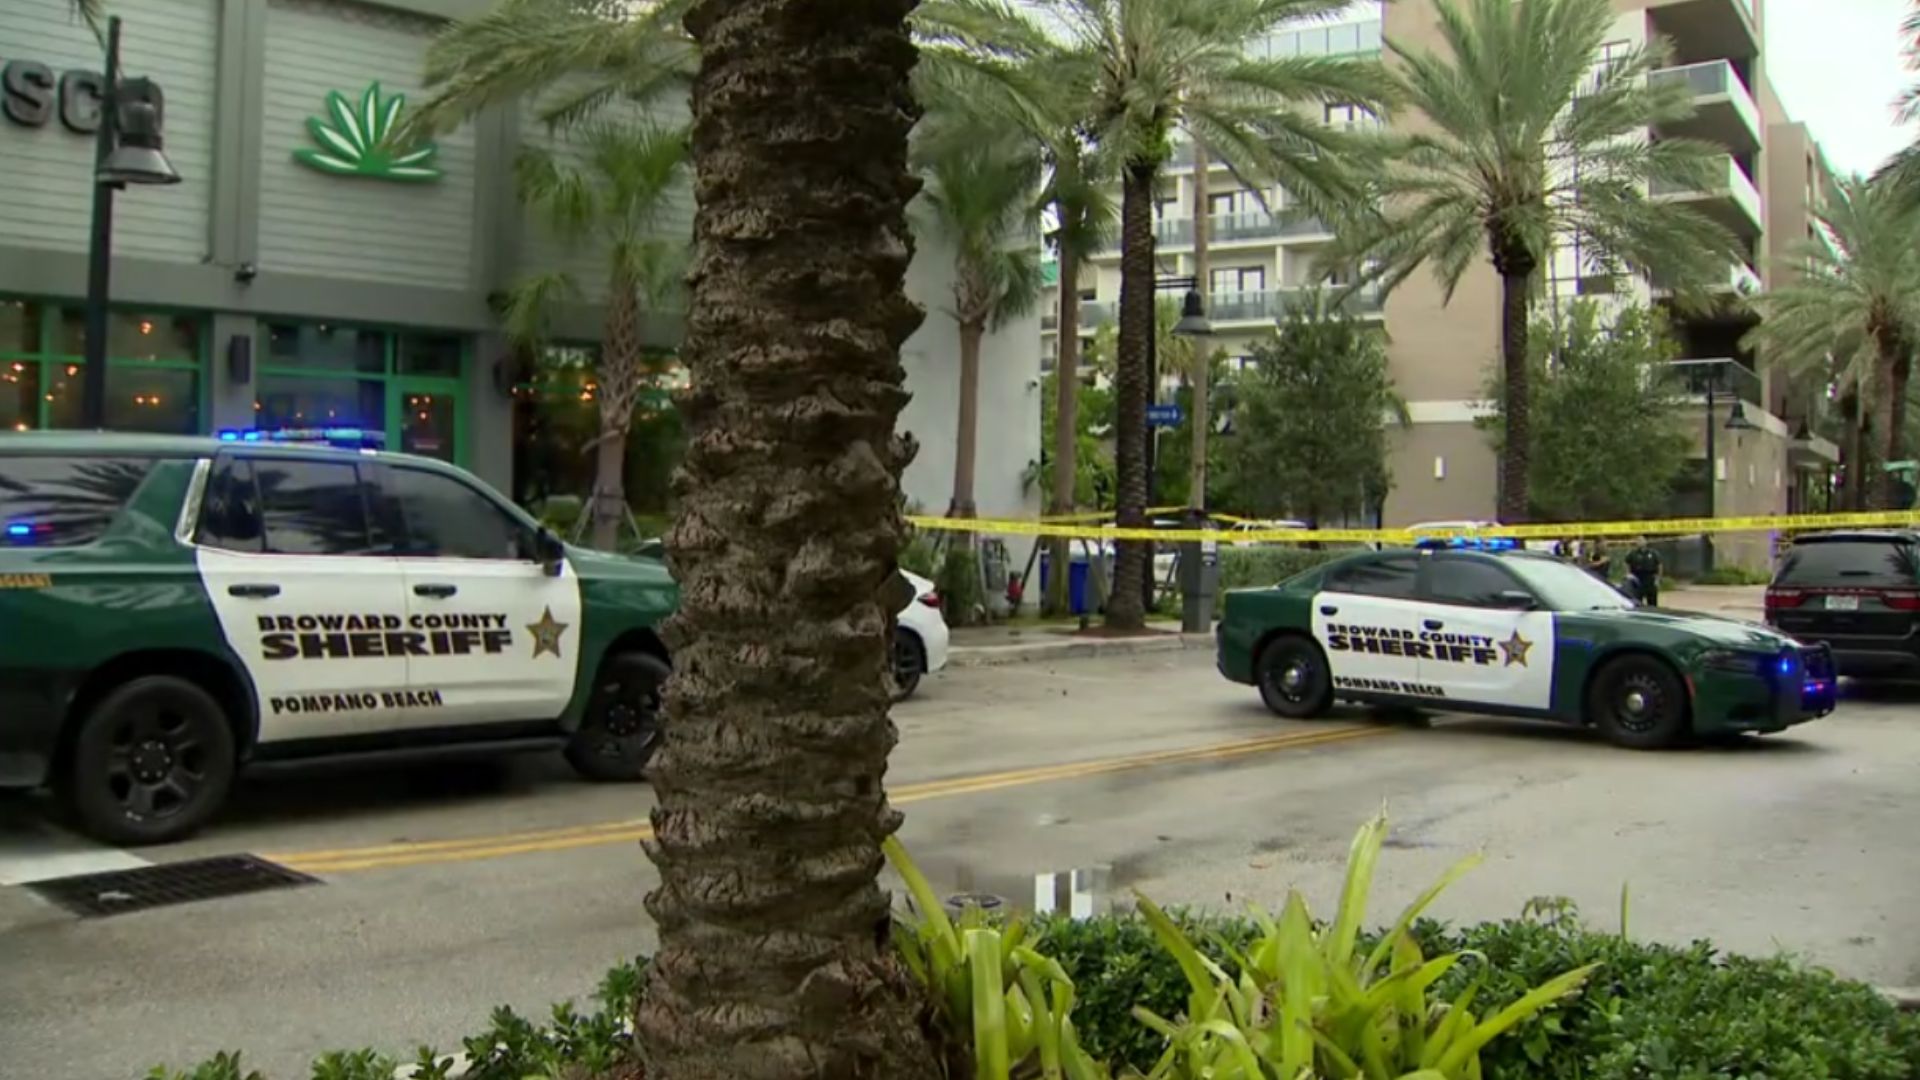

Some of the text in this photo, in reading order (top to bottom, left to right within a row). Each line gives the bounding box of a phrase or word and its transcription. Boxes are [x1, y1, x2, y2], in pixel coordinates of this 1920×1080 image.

[258, 614, 507, 632] BROWARD COUNTY
[261, 631, 513, 659] SHERIFF
[1327, 624, 1493, 647] BROWARD COUNTY
[1328, 635, 1498, 665] SHERIFF
[1335, 677, 1446, 696] POMPANO BEACH
[271, 691, 443, 714] POMPANO BEACH
